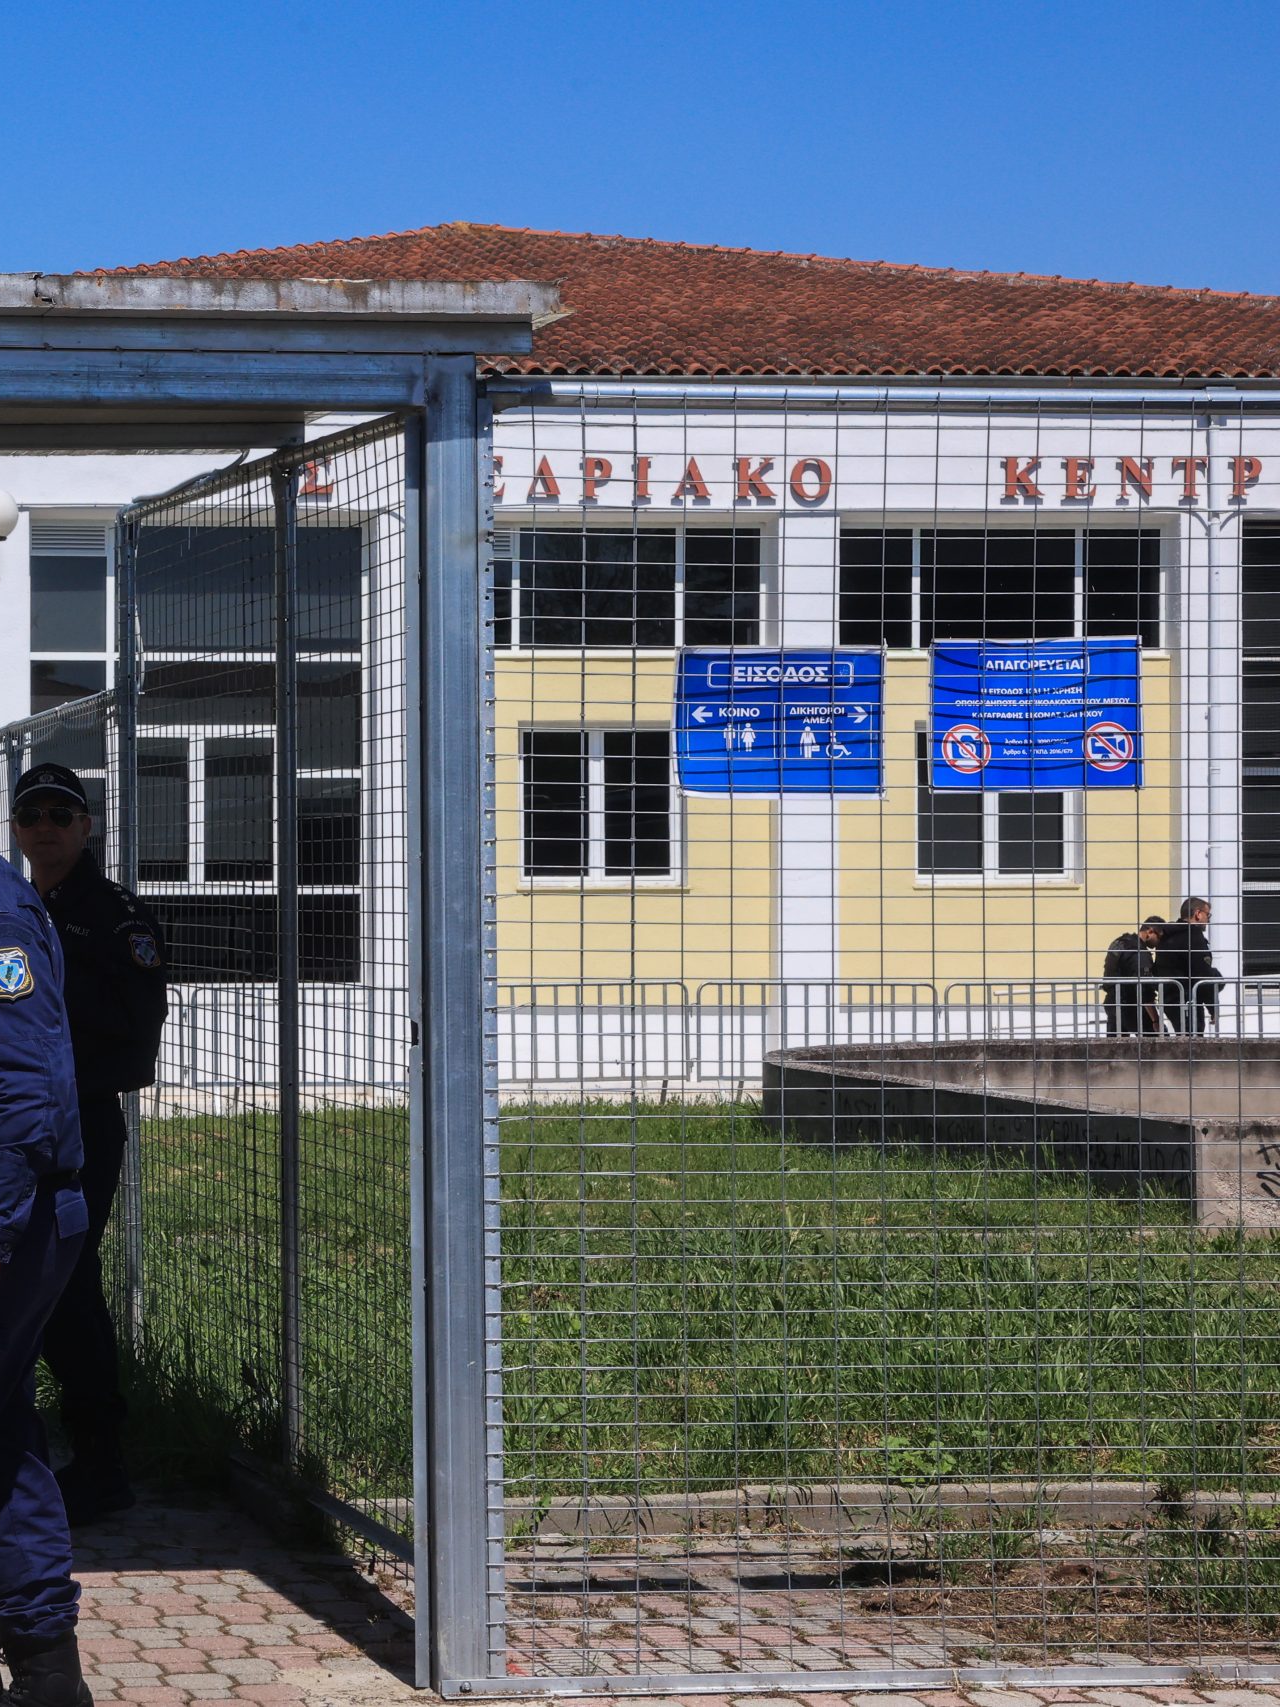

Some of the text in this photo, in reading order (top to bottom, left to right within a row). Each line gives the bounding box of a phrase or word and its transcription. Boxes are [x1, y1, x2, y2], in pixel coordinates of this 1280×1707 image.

[985, 658, 1084, 671] ΑΠΑΓΟΡΕΥΕΤΑΙ
[733, 666, 829, 682] ΕΙΣΟΔΟΣ
[719, 708, 760, 717] ΚΟΙΝΟ
[790, 707, 845, 715] ΔΙΚΗΓΟΡΟΙ
[803, 716, 833, 724] ΑΜΕΑ
